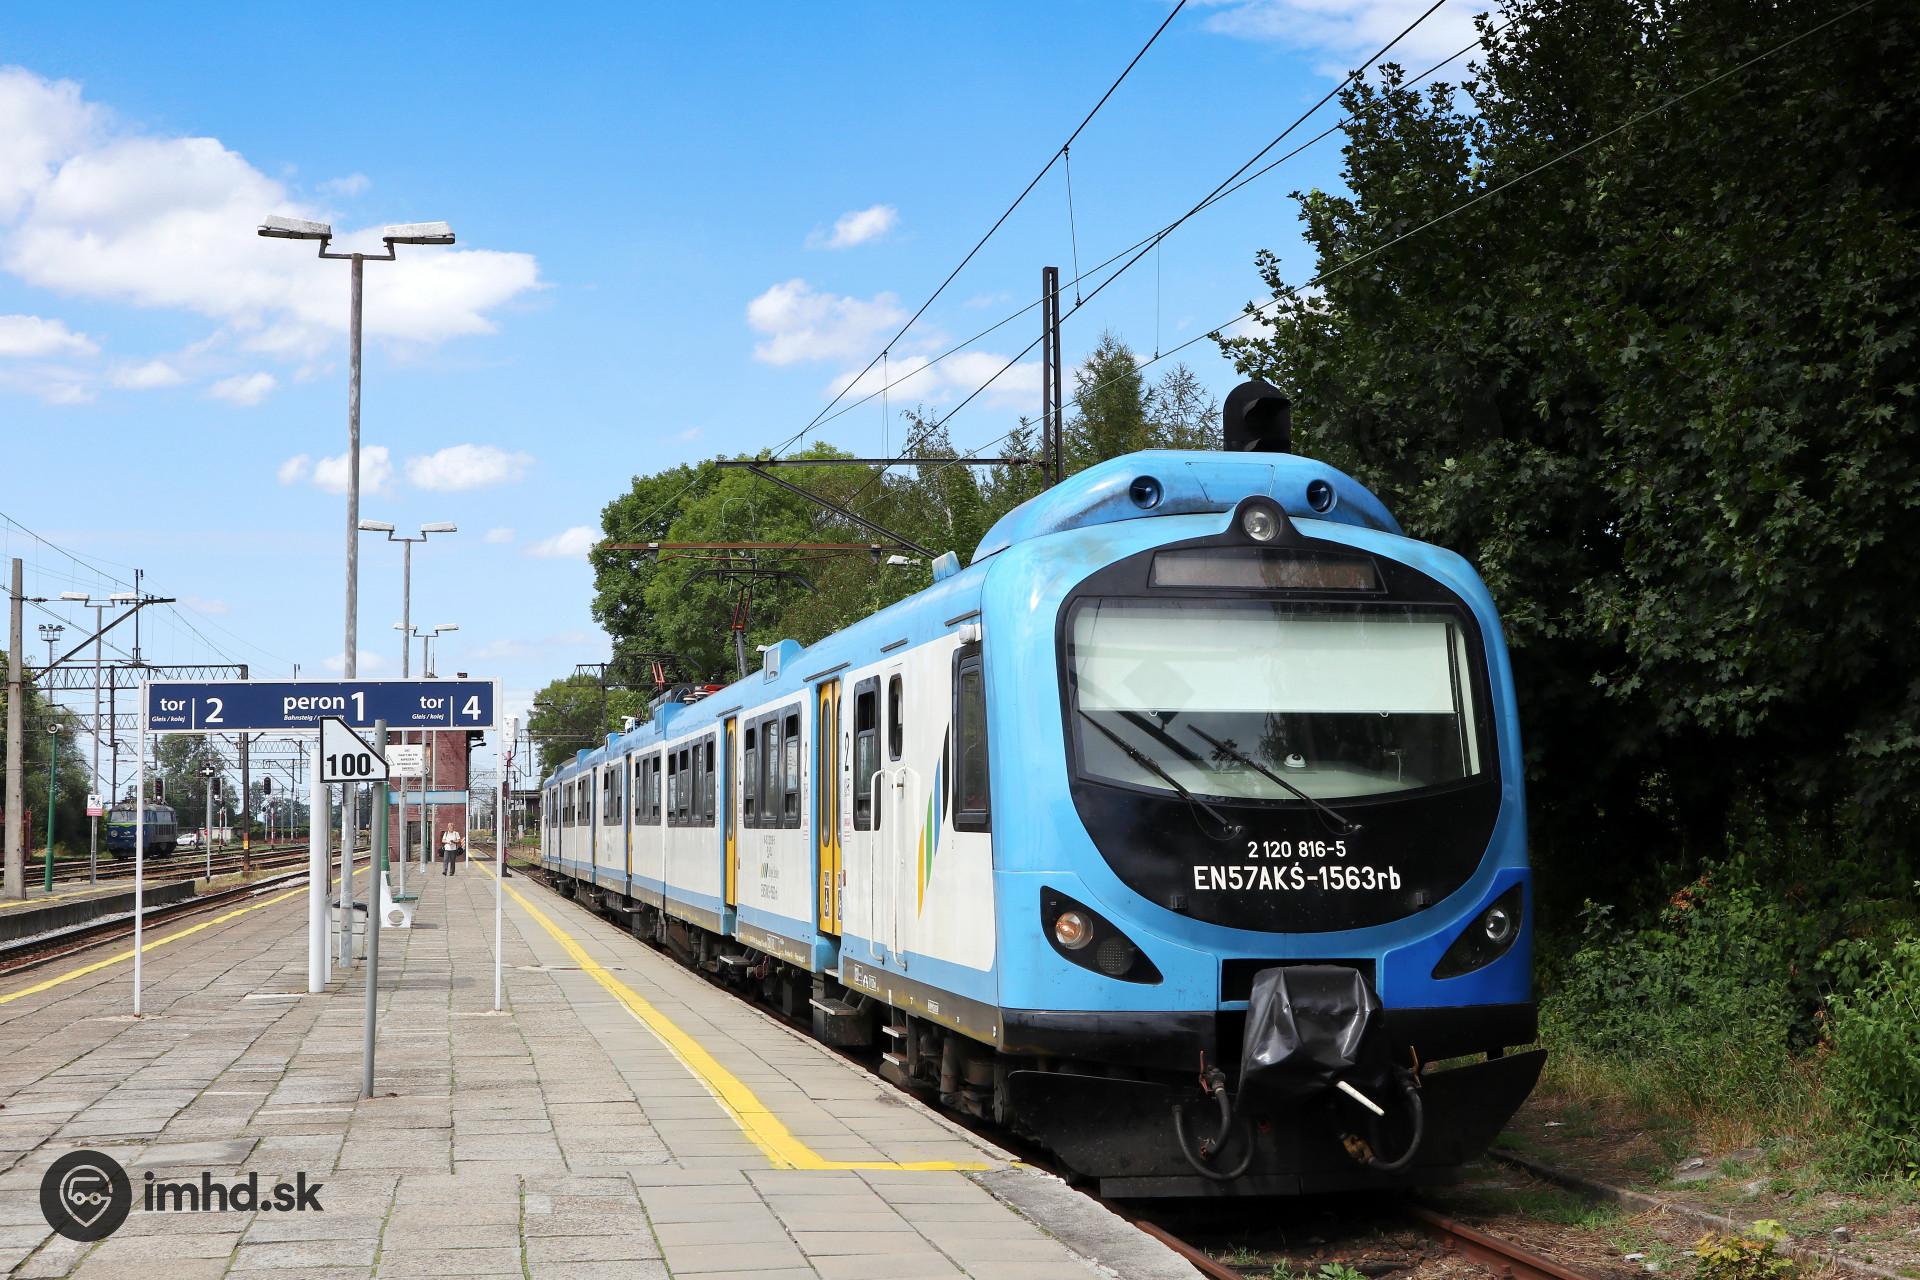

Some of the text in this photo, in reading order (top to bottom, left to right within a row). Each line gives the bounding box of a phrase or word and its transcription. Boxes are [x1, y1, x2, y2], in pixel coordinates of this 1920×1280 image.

[159, 698, 224, 723] tor 2
[283, 714, 313, 722] Bahnsteig
[284, 692, 364, 721] peron 1
[419, 695, 482, 721] tor 4
[429, 713, 445, 721] kolej
[170, 715, 186, 724] kolej
[326, 753, 370, 777] 100
[1247, 840, 1347, 858] 2 120 816-5
[1193, 861, 1402, 891] EN57AKŚ-1563rb
